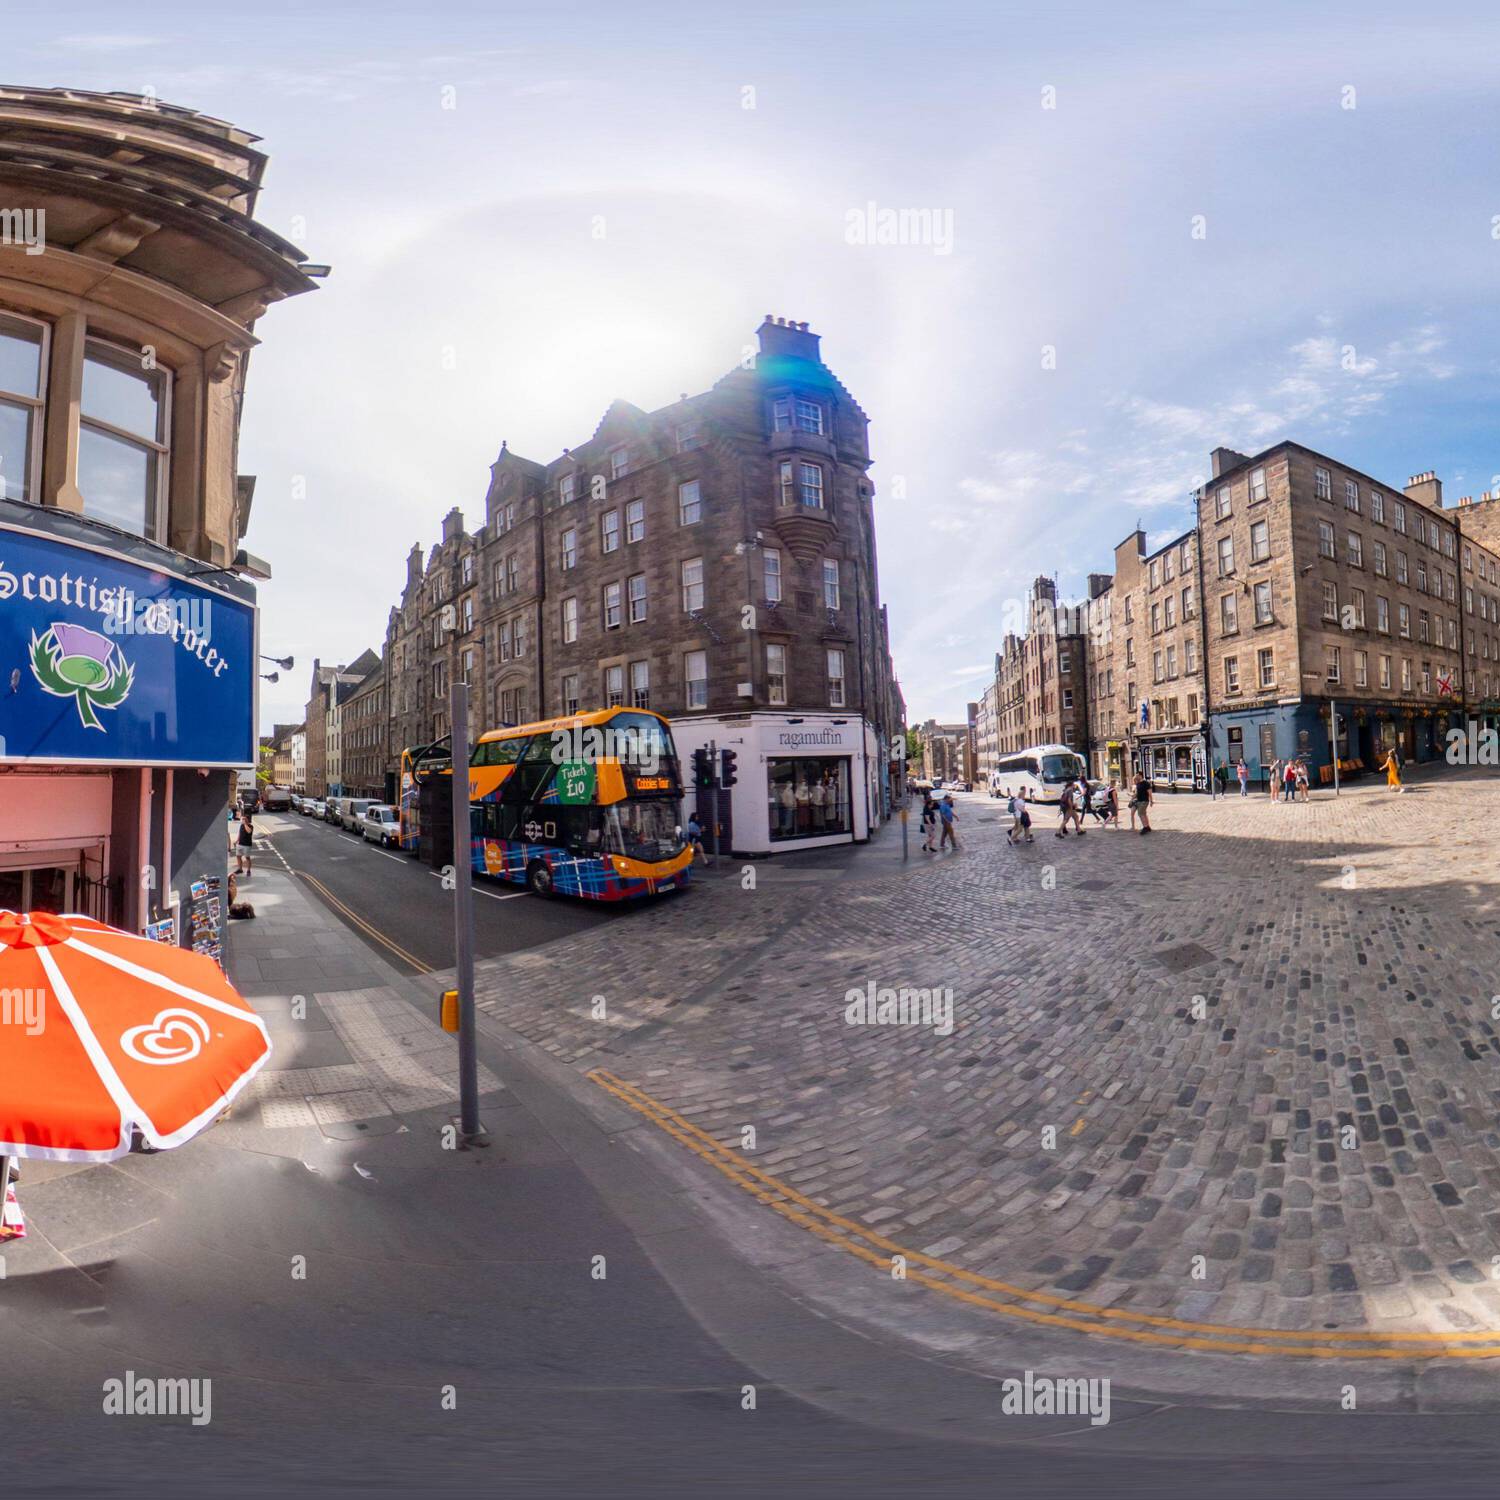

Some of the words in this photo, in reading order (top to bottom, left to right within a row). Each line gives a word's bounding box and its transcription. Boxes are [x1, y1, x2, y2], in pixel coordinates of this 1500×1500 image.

[144, 601, 229, 678] Grocer
[779, 728, 842, 750] ragamuffin
[562, 765, 588, 780] Tickets
[566, 779, 585, 797] £10
